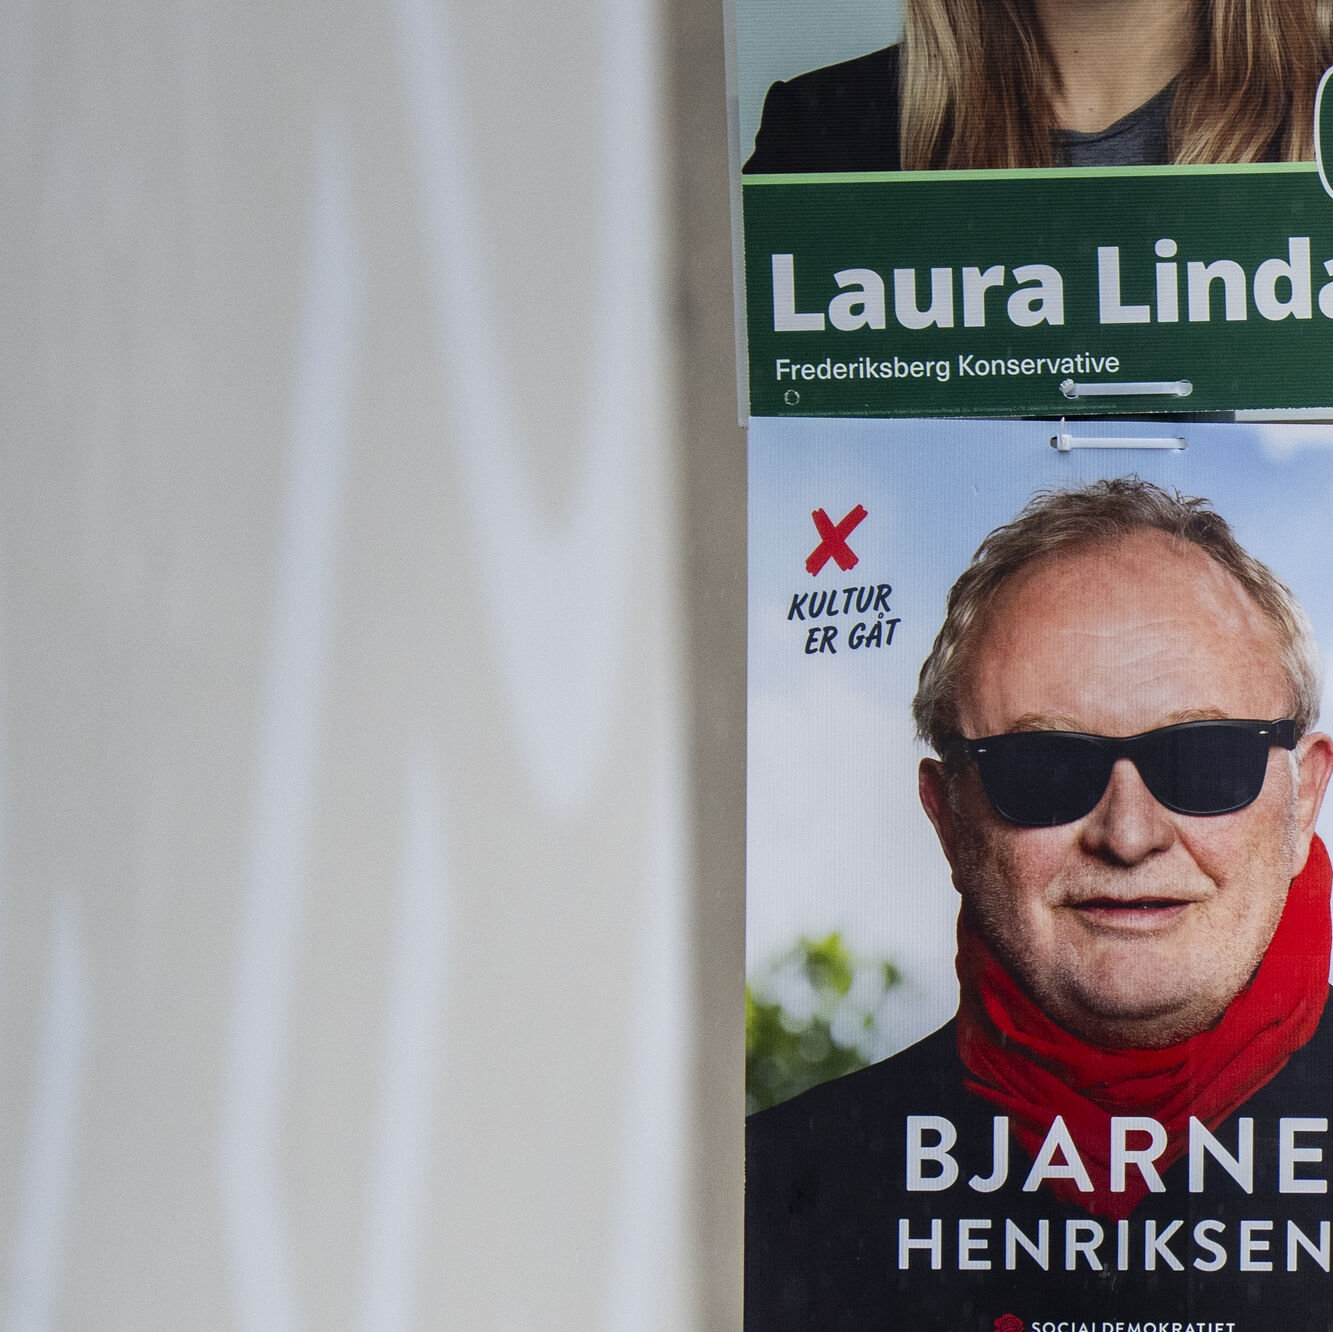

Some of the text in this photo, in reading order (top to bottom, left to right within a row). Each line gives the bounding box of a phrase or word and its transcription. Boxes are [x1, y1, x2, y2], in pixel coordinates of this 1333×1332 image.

[772, 253, 1065, 332] Laura
[775, 351, 1120, 383] Frederiksberg Konservative
[787, 583, 892, 621] KULTUR
[804, 612, 901, 655] ER GÅT
[906, 1114, 1329, 1195] BJARNE
[898, 1217, 1332, 1273] HENRIKSEN
